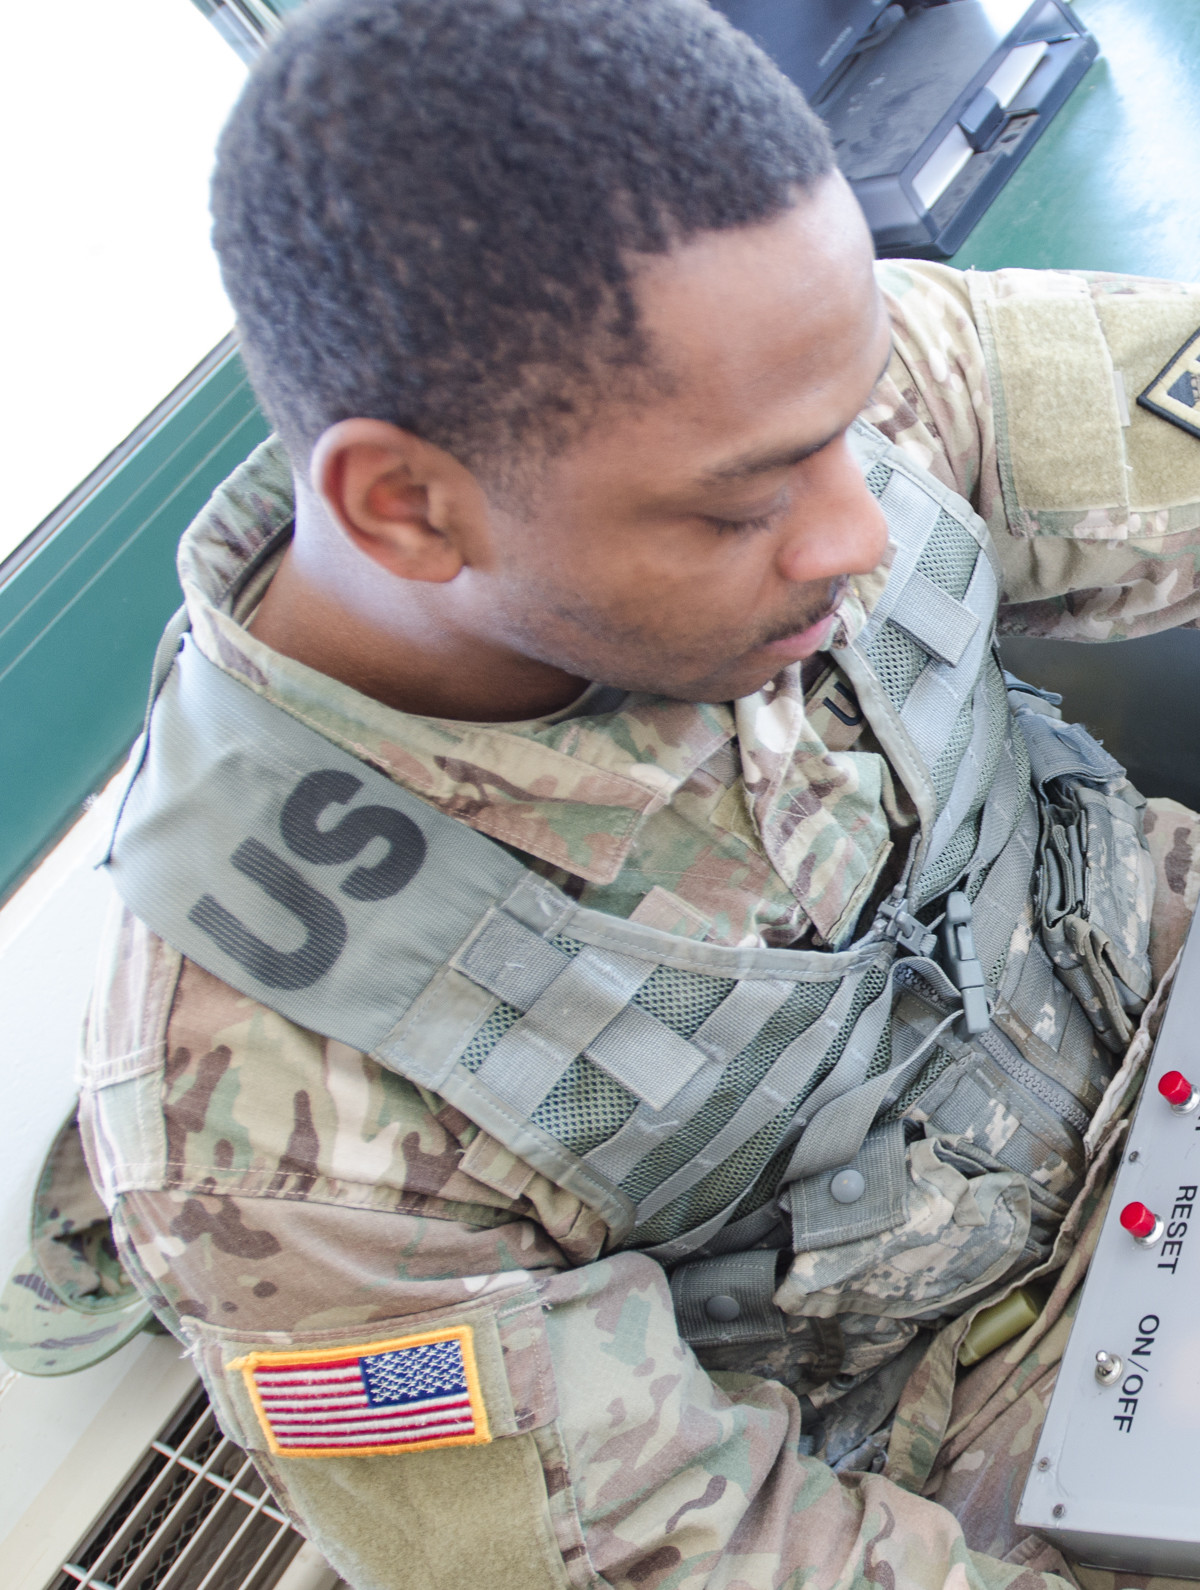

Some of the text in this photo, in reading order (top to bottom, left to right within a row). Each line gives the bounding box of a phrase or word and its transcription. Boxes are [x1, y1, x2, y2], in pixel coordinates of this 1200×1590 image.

[187, 768, 428, 991] US
[1157, 1185, 1199, 1275] RESET
[1112, 1313, 1160, 1433] ON/OFF
